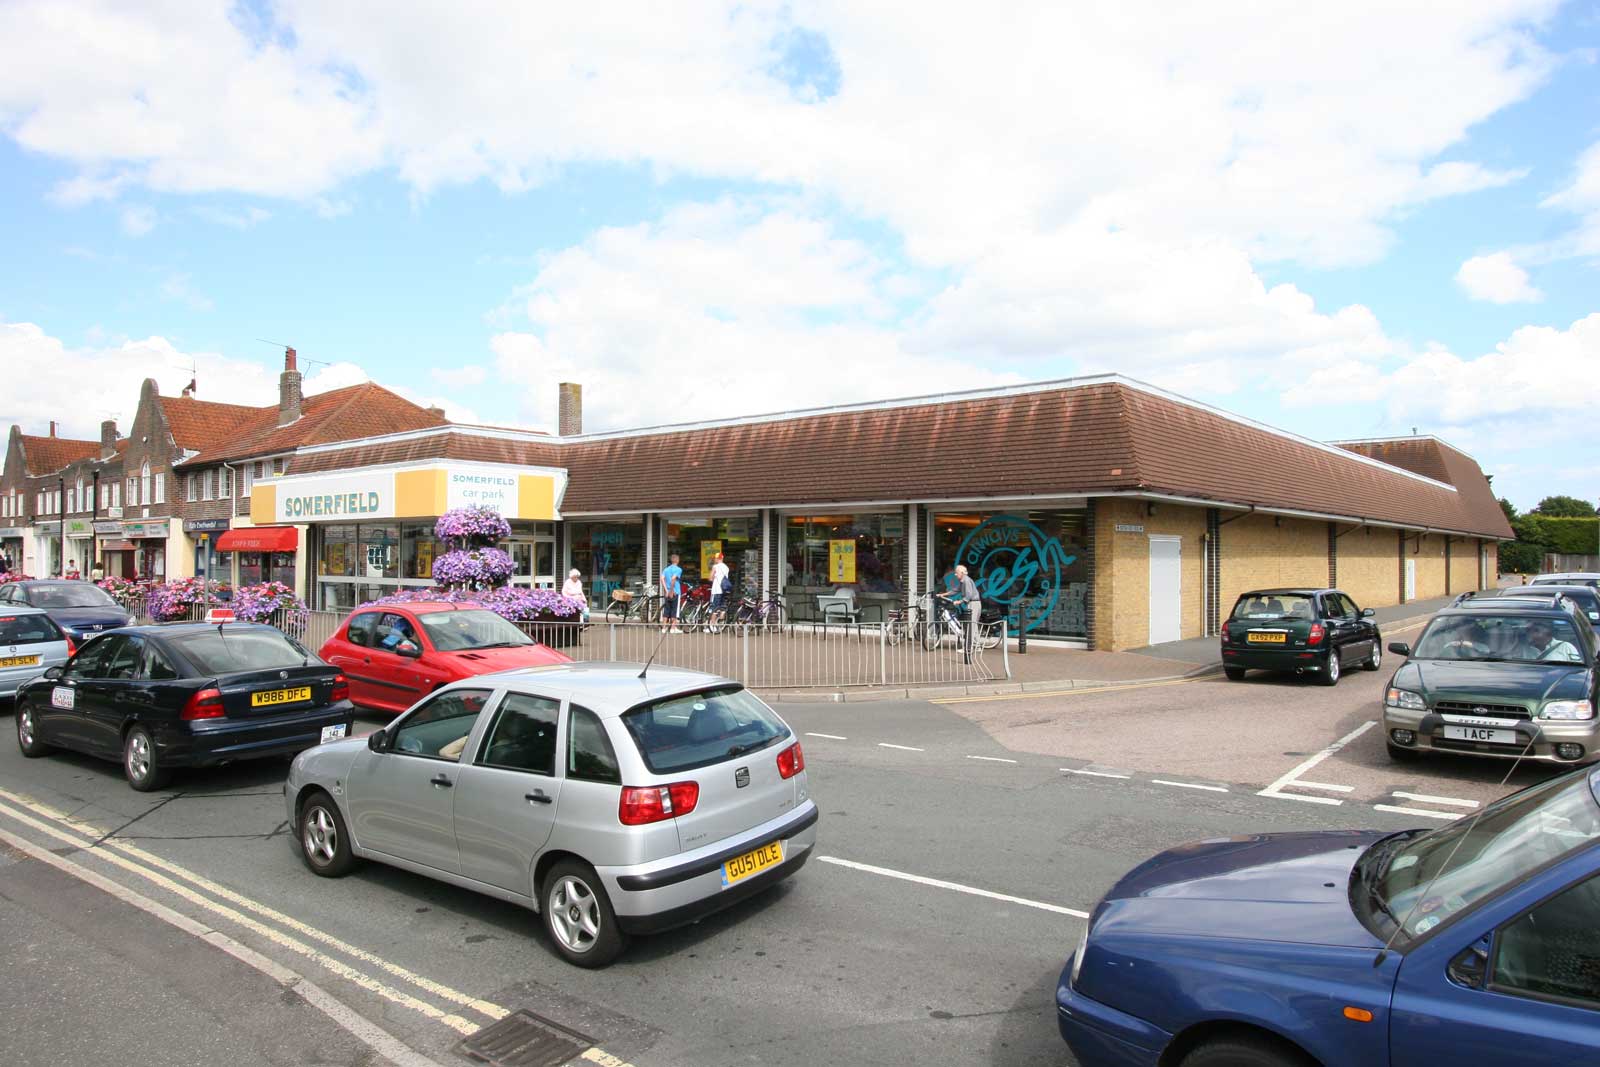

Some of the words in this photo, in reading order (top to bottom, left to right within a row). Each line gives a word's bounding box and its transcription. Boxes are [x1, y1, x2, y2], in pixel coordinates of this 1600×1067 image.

[453, 474, 515, 486] SOMERFIELD
[462, 490, 478, 498] car
[481, 489, 504, 501] park
[285, 491, 379, 517] SOMERFIELD
[967, 527, 1020, 565] always
[256, 691, 284, 704] W986
[287, 688, 307, 700] DFC
[1471, 729, 1496, 740] ACF
[729, 853, 757, 878] GU51
[757, 844, 779, 867] DLE
